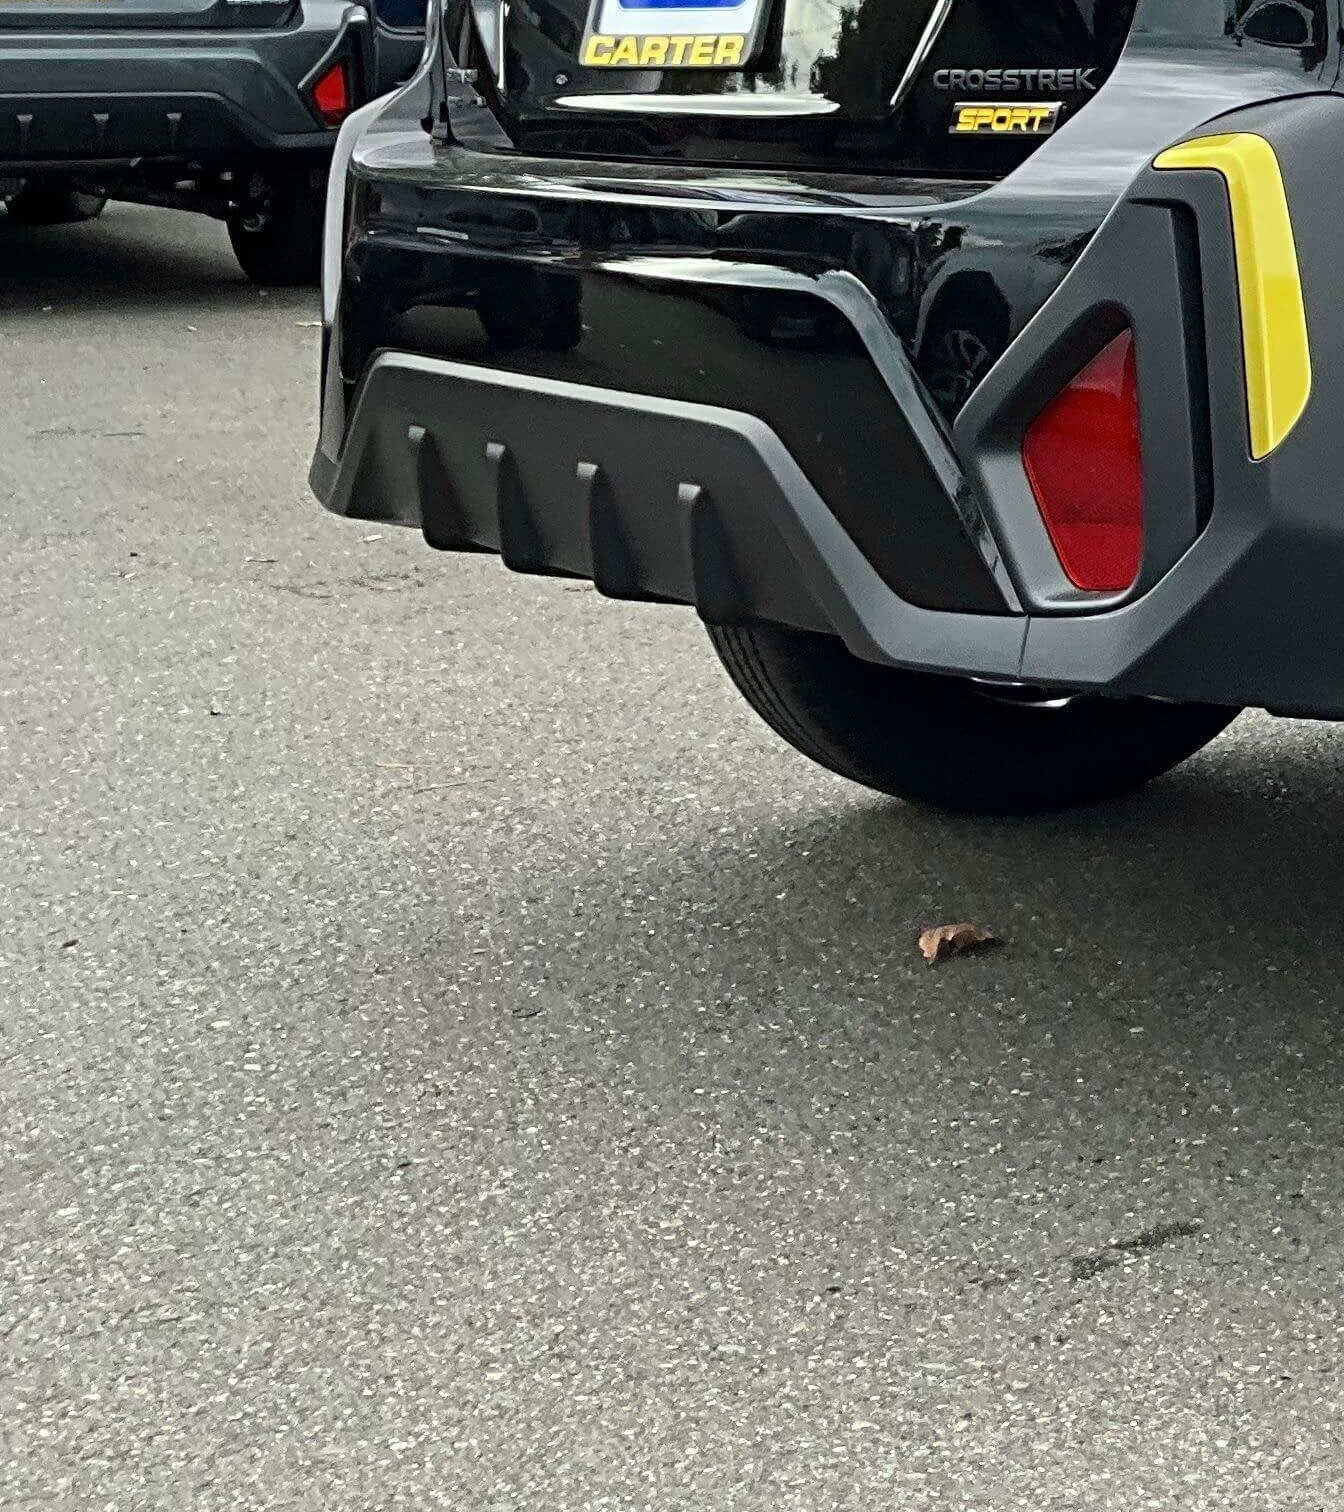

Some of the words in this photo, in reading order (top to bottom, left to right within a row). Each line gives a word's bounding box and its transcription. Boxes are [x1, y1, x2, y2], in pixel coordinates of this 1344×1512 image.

[584, 35, 744, 65] CARTER
[933, 68, 1097, 90] CROSSTREK
[956, 108, 1050, 132] SPORT
